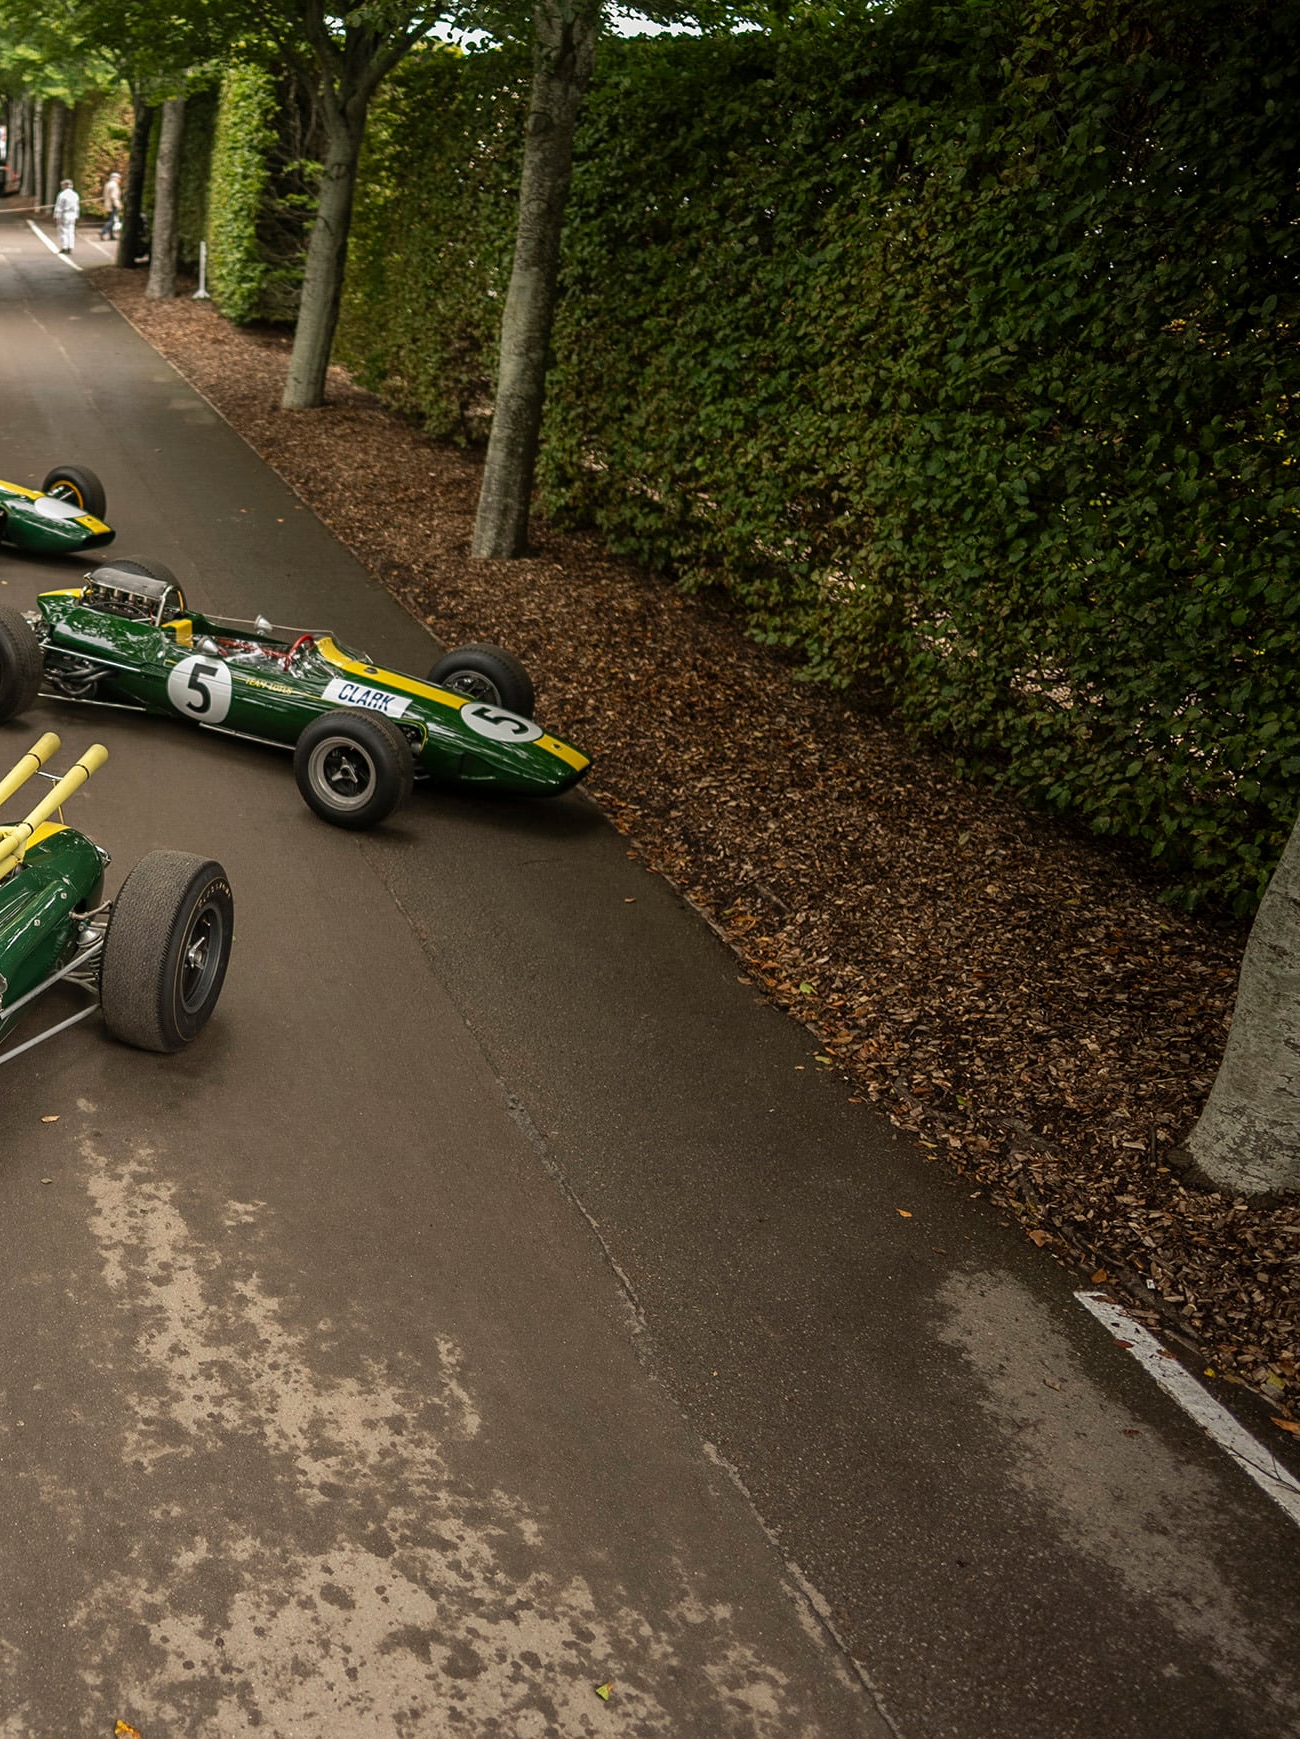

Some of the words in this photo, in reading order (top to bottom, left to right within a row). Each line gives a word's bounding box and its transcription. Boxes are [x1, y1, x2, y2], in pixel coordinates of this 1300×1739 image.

[186, 663, 218, 714] 5
[246, 679, 267, 688] TEAM
[268, 683, 293, 694] LOTUS
[338, 683, 395, 712] CLARK
[471, 707, 529, 735] 5
